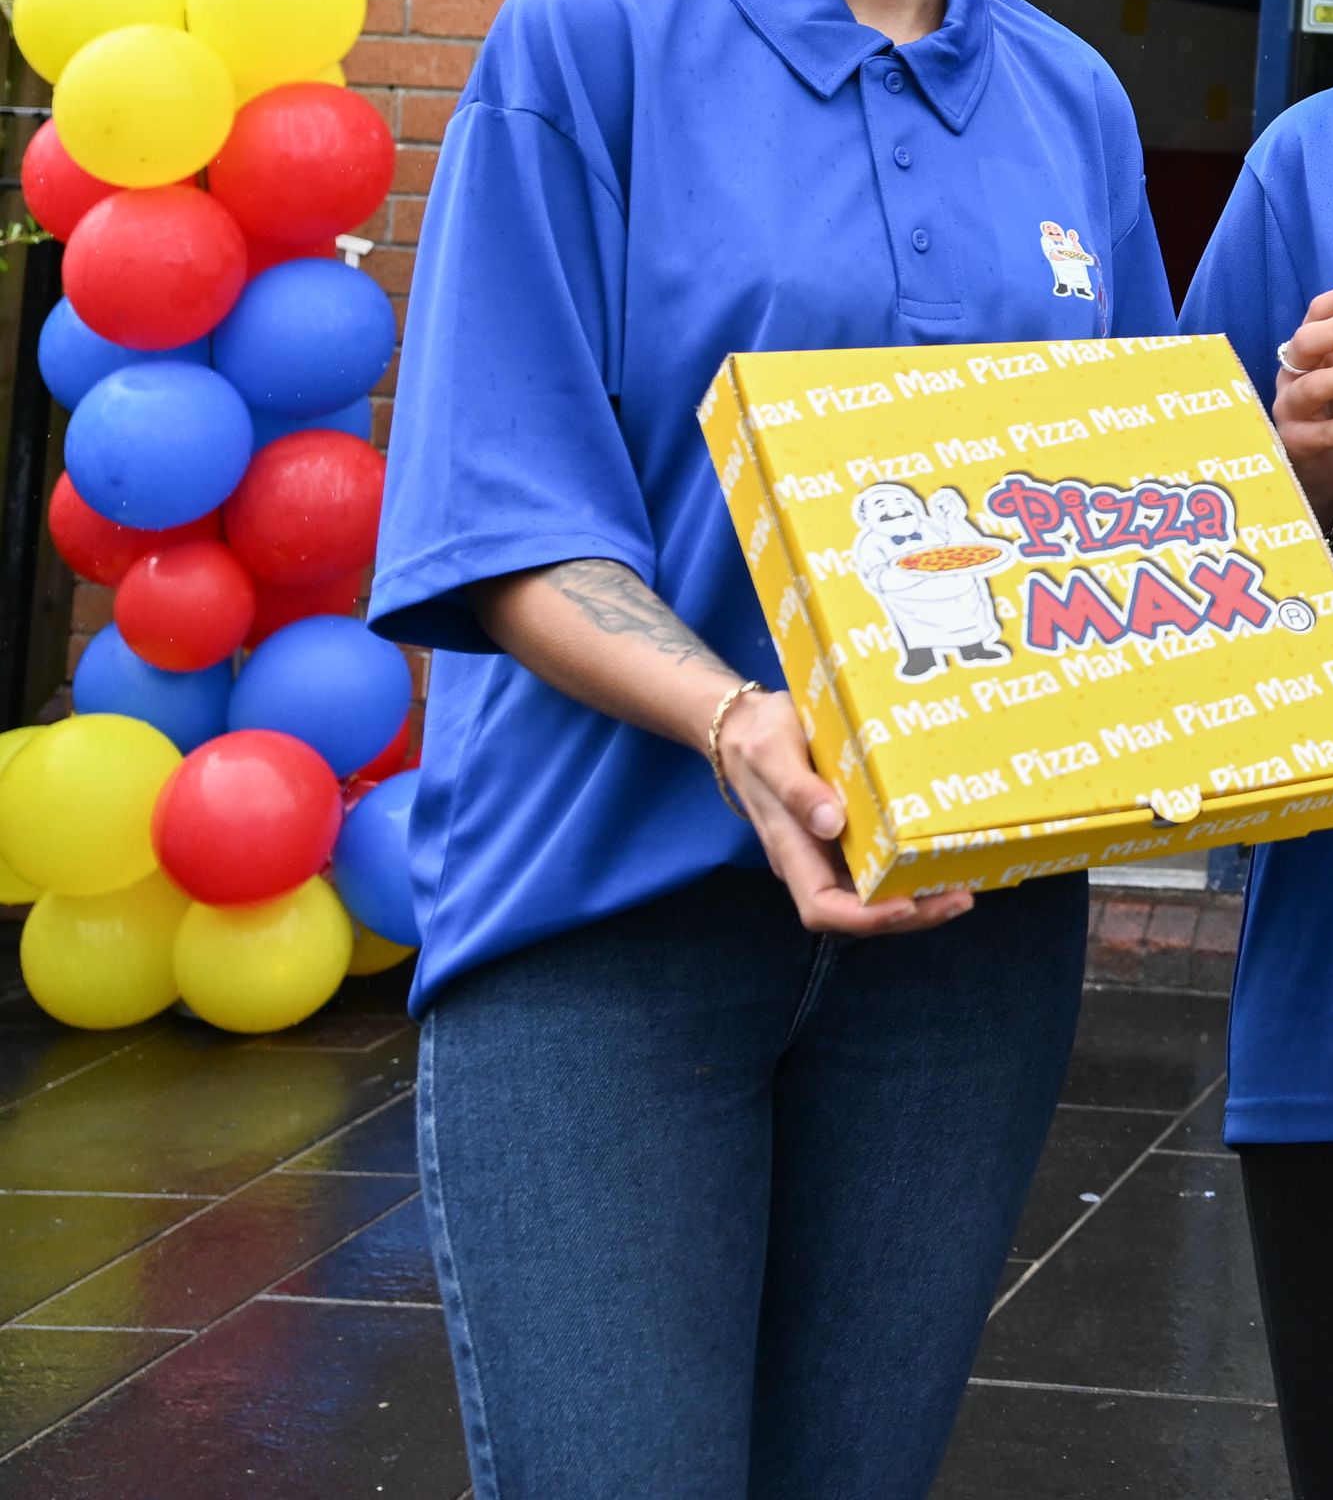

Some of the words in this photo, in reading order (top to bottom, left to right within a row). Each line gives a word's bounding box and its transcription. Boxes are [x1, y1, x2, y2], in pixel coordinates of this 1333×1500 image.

[806, 385, 893, 417] Pizza
[893, 368, 965, 399] Max
[967, 352, 1048, 384] Pizza
[1050, 340, 1115, 368] Max
[774, 471, 844, 508] Max
[846, 453, 934, 486] Pizza
[934, 436, 1006, 468] Max
[1007, 418, 1090, 452] Pizza
[1088, 404, 1156, 434] Max
[1156, 388, 1233, 420] Pizza
[1197, 453, 1276, 482] Pizza
[986, 477, 1232, 559] Pizza
[1241, 520, 1315, 554] Pizza
[1024, 556, 1274, 652] MAX
[890, 695, 969, 736] Max
[970, 670, 1061, 713] Pizza
[1061, 649, 1132, 688] Max
[930, 768, 1009, 811] Max
[1011, 741, 1100, 786] Pizza
[1099, 719, 1173, 758] Max
[1172, 693, 1257, 736] Pizza
[1255, 674, 1323, 710] Max
[1209, 762, 1293, 794] Pizza
